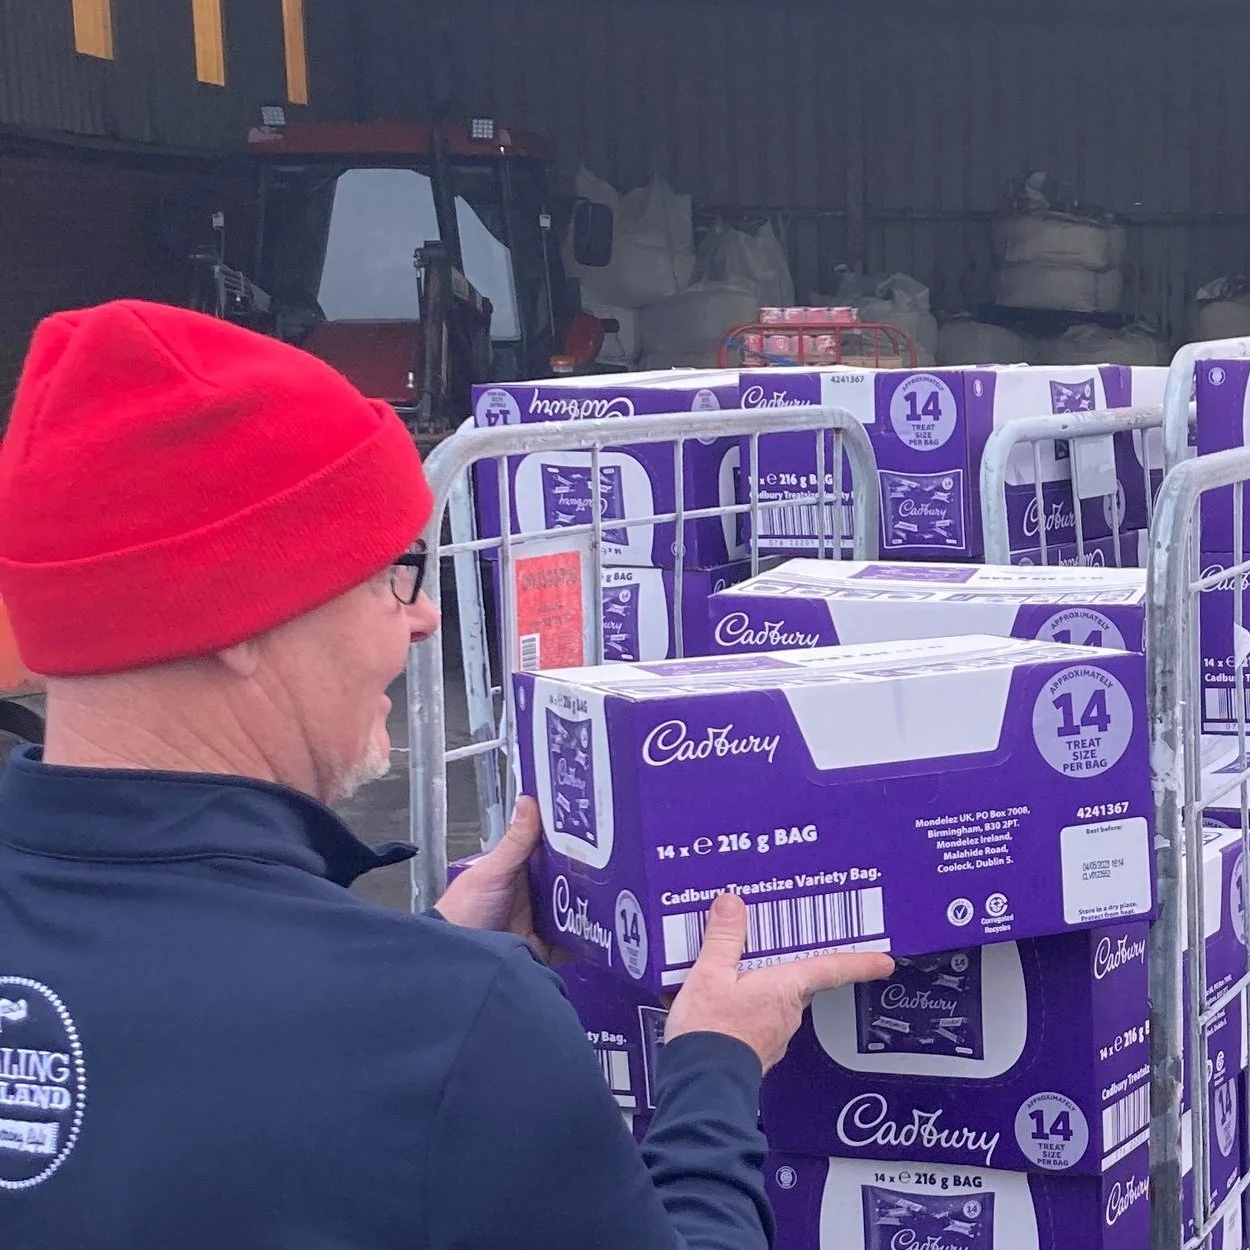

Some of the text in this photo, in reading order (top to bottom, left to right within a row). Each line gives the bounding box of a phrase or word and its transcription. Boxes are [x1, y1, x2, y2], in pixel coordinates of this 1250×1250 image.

[830, 375, 865, 383] 4241367
[904, 391, 942, 421] 14
[898, 499, 947, 520] Cadbury
[614, 572, 632, 581] BAG
[714, 611, 820, 648] Cadbury
[1050, 610, 1110, 631] APPROXIMATELY
[1050, 669, 1114, 695] APPROXIMATELY
[1052, 689, 1111, 737] 14
[642, 720, 780, 767] Cadbury
[1066, 738, 1101, 750] TREAT
[1063, 759, 1108, 772] PER BAG
[1072, 750, 1097, 760] SIZE
[915, 815, 958, 828] Mondelez
[959, 812, 974, 822] UK,
[976, 811, 988, 820] PO
[990, 809, 1006, 819] Box
[1076, 801, 1129, 819] 4241367
[928, 820, 1020, 838] Birmingham, B30 2PT.
[657, 825, 818, 859] 14 x 216 g BAG
[936, 832, 1013, 849] Mondelez Ireland,
[943, 845, 1009, 861] Malahide Road,
[937, 861, 974, 873] Coolock,
[976, 857, 1004, 868] Dublin
[661, 867, 882, 905] Cadbury Treatsize Variety Bag.
[552, 874, 613, 967] Cadbury
[620, 908, 641, 945] 14
[1094, 934, 1147, 981] Cadbury
[880, 983, 958, 1015] Cadbury
[601, 1032, 627, 1044] Bag.
[836, 1092, 1000, 1166] Cadbury
[1029, 1110, 1073, 1141] 14
[874, 1173, 983, 1188] 14 216 BAG
[1105, 1174, 1150, 1227] Cadbury
